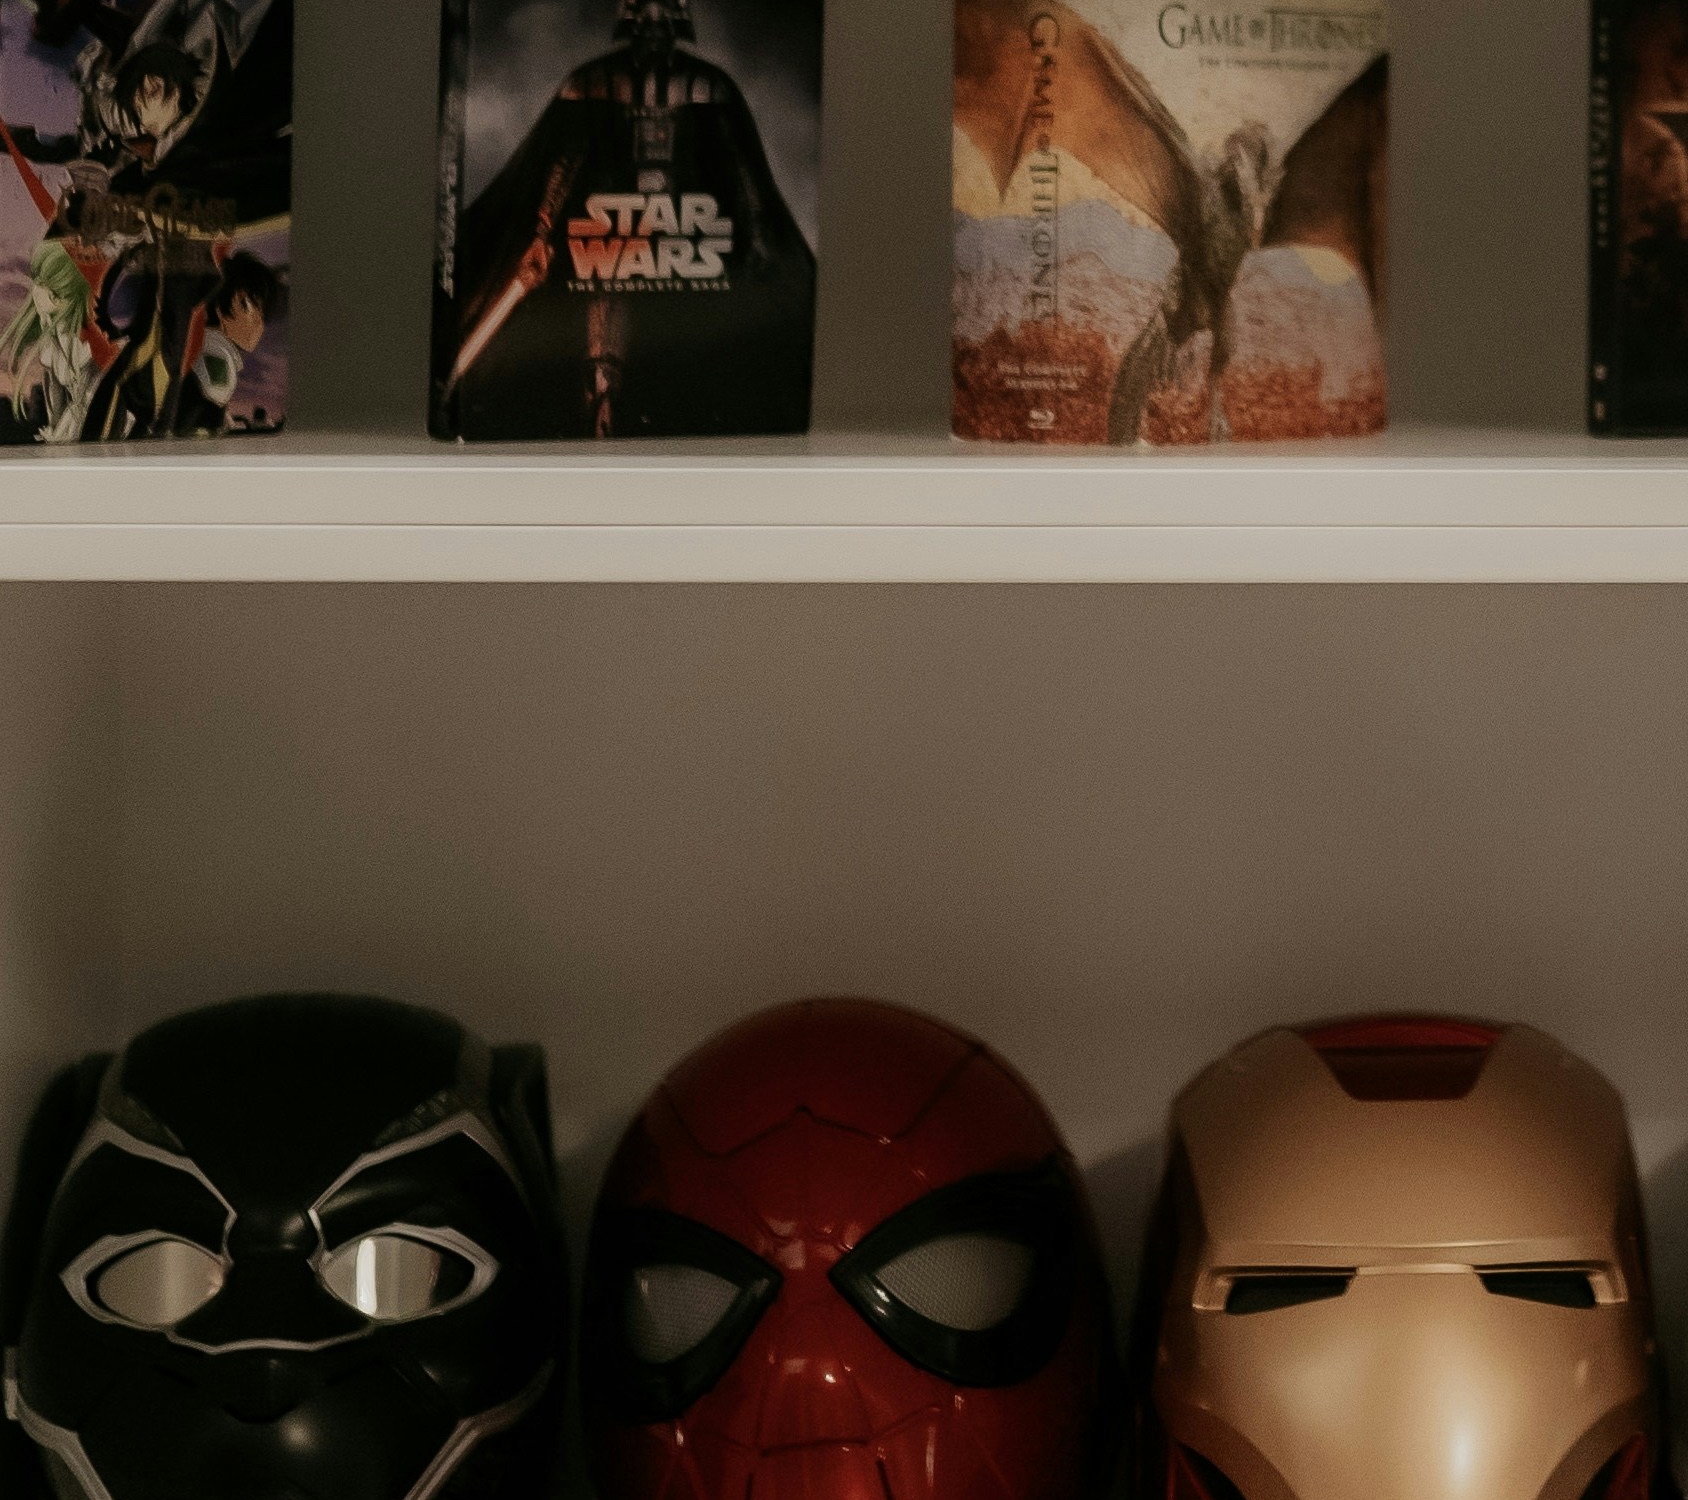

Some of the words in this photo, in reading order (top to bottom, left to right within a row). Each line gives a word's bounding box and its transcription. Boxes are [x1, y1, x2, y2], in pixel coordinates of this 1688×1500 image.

[1158, 4, 1243, 49] GAME
[1029, 11, 1060, 126] GAME
[568, 193, 732, 236] STAR
[568, 238, 732, 279] WARS
[568, 280, 595, 292] THE
[604, 280, 683, 292] COMPLETE
